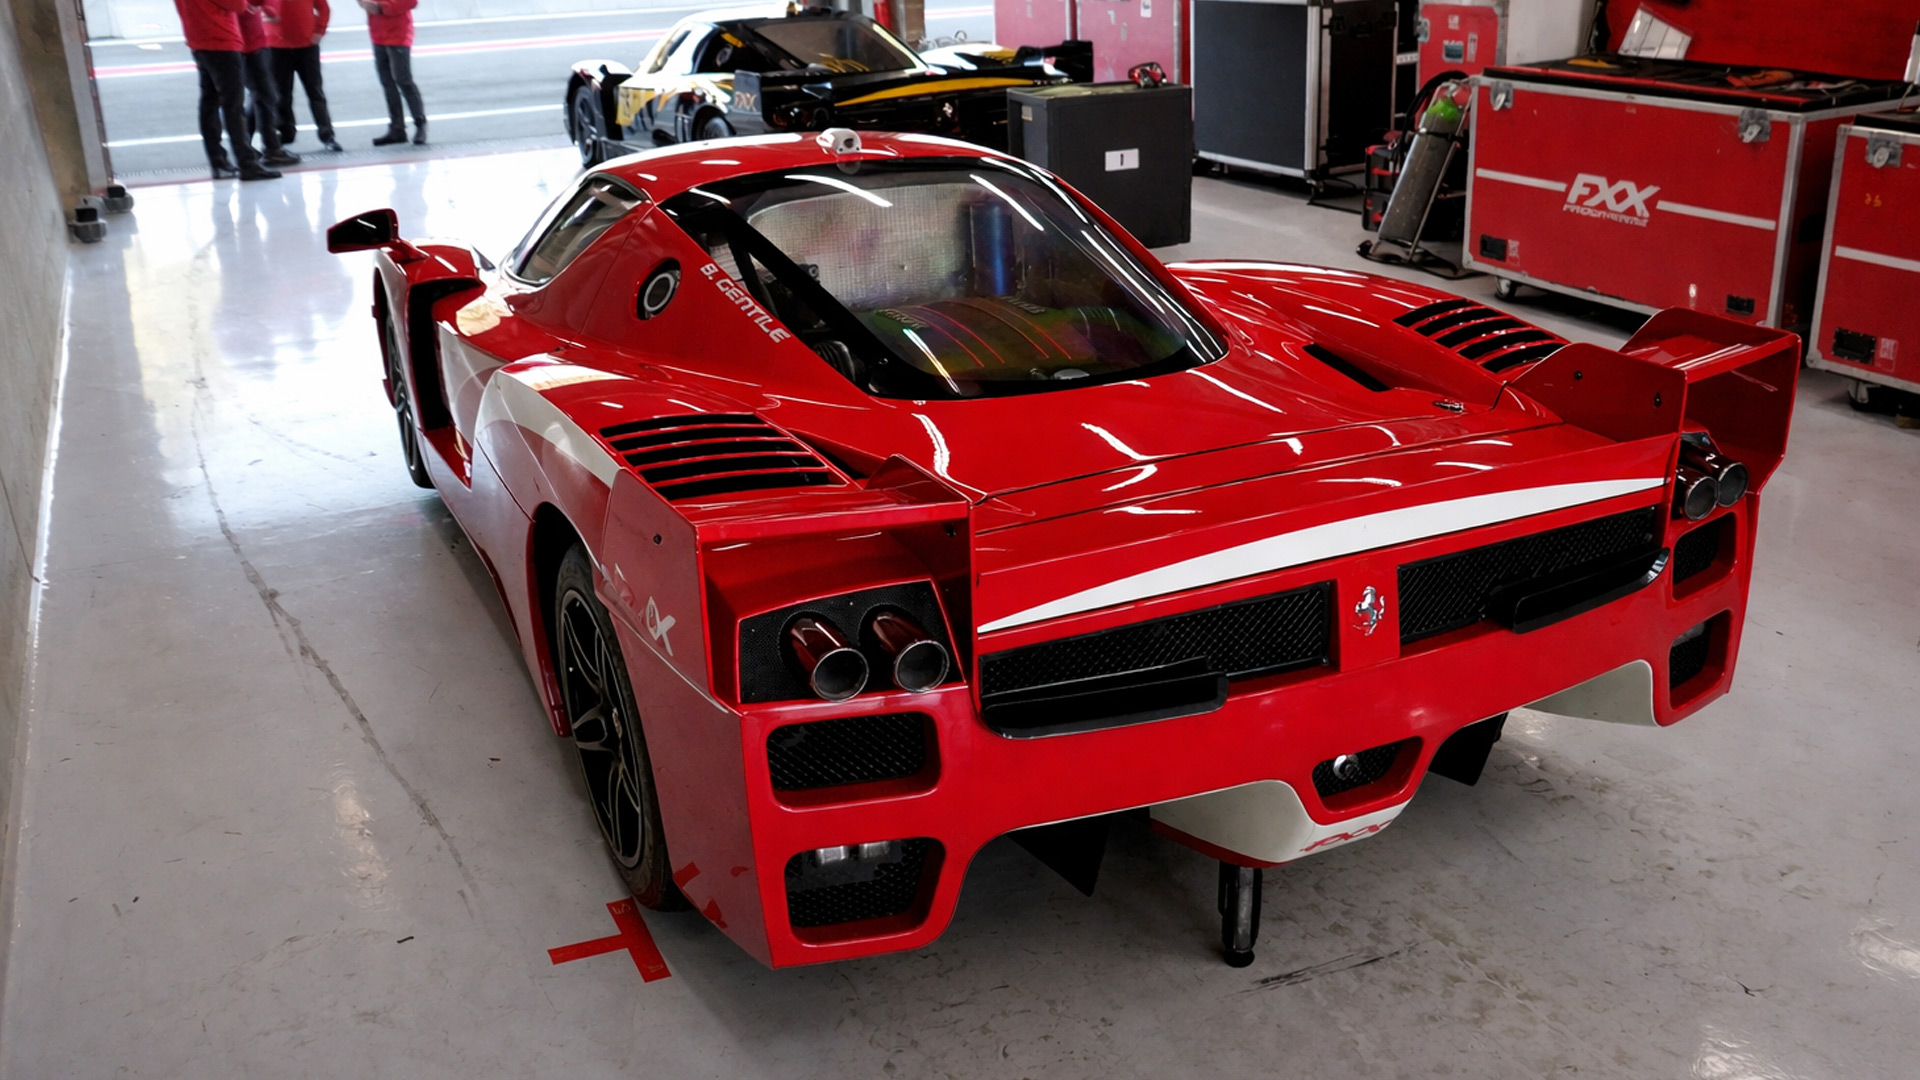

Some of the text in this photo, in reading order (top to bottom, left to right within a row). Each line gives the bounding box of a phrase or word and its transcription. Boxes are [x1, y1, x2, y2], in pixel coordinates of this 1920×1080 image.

[1566, 172, 1661, 218] FXX
[699, 262, 791, 344] B. GENTILE
